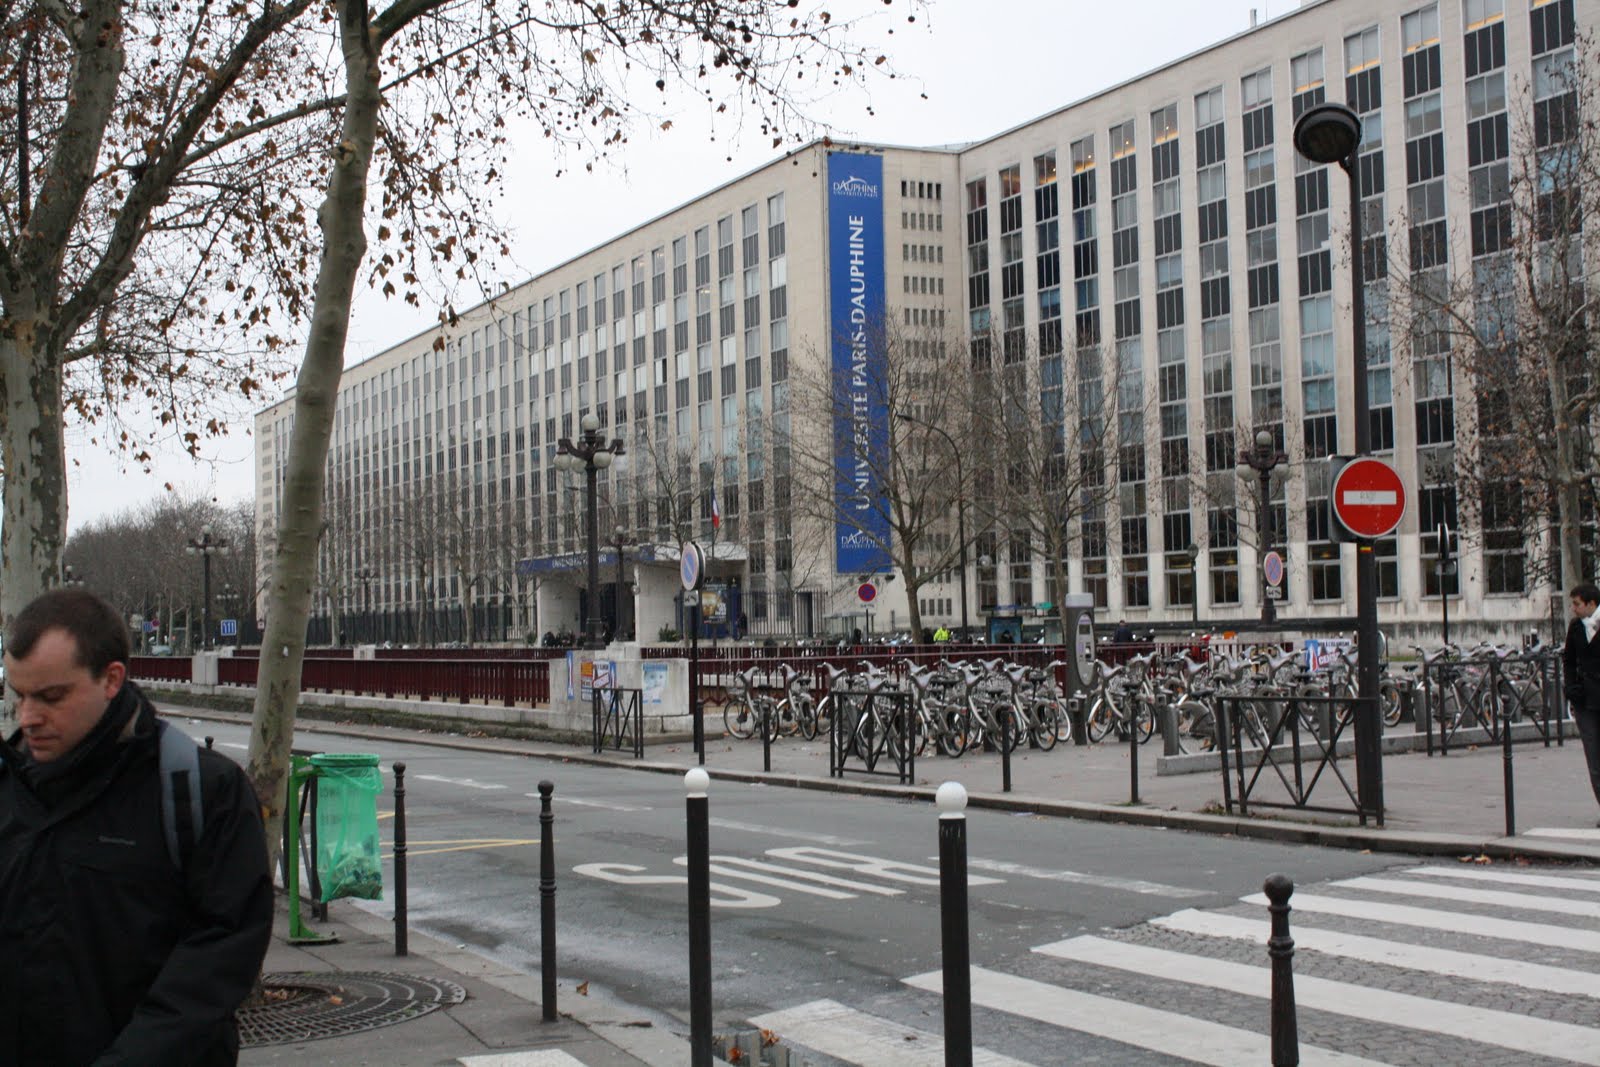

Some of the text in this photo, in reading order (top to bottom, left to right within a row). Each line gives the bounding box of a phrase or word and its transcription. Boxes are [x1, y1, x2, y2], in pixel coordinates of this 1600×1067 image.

[833, 179, 877, 193] DAUPHINE
[848, 215, 868, 387] PARIS-DAUPHINE
[572, 846, 1007, 908] BUS
